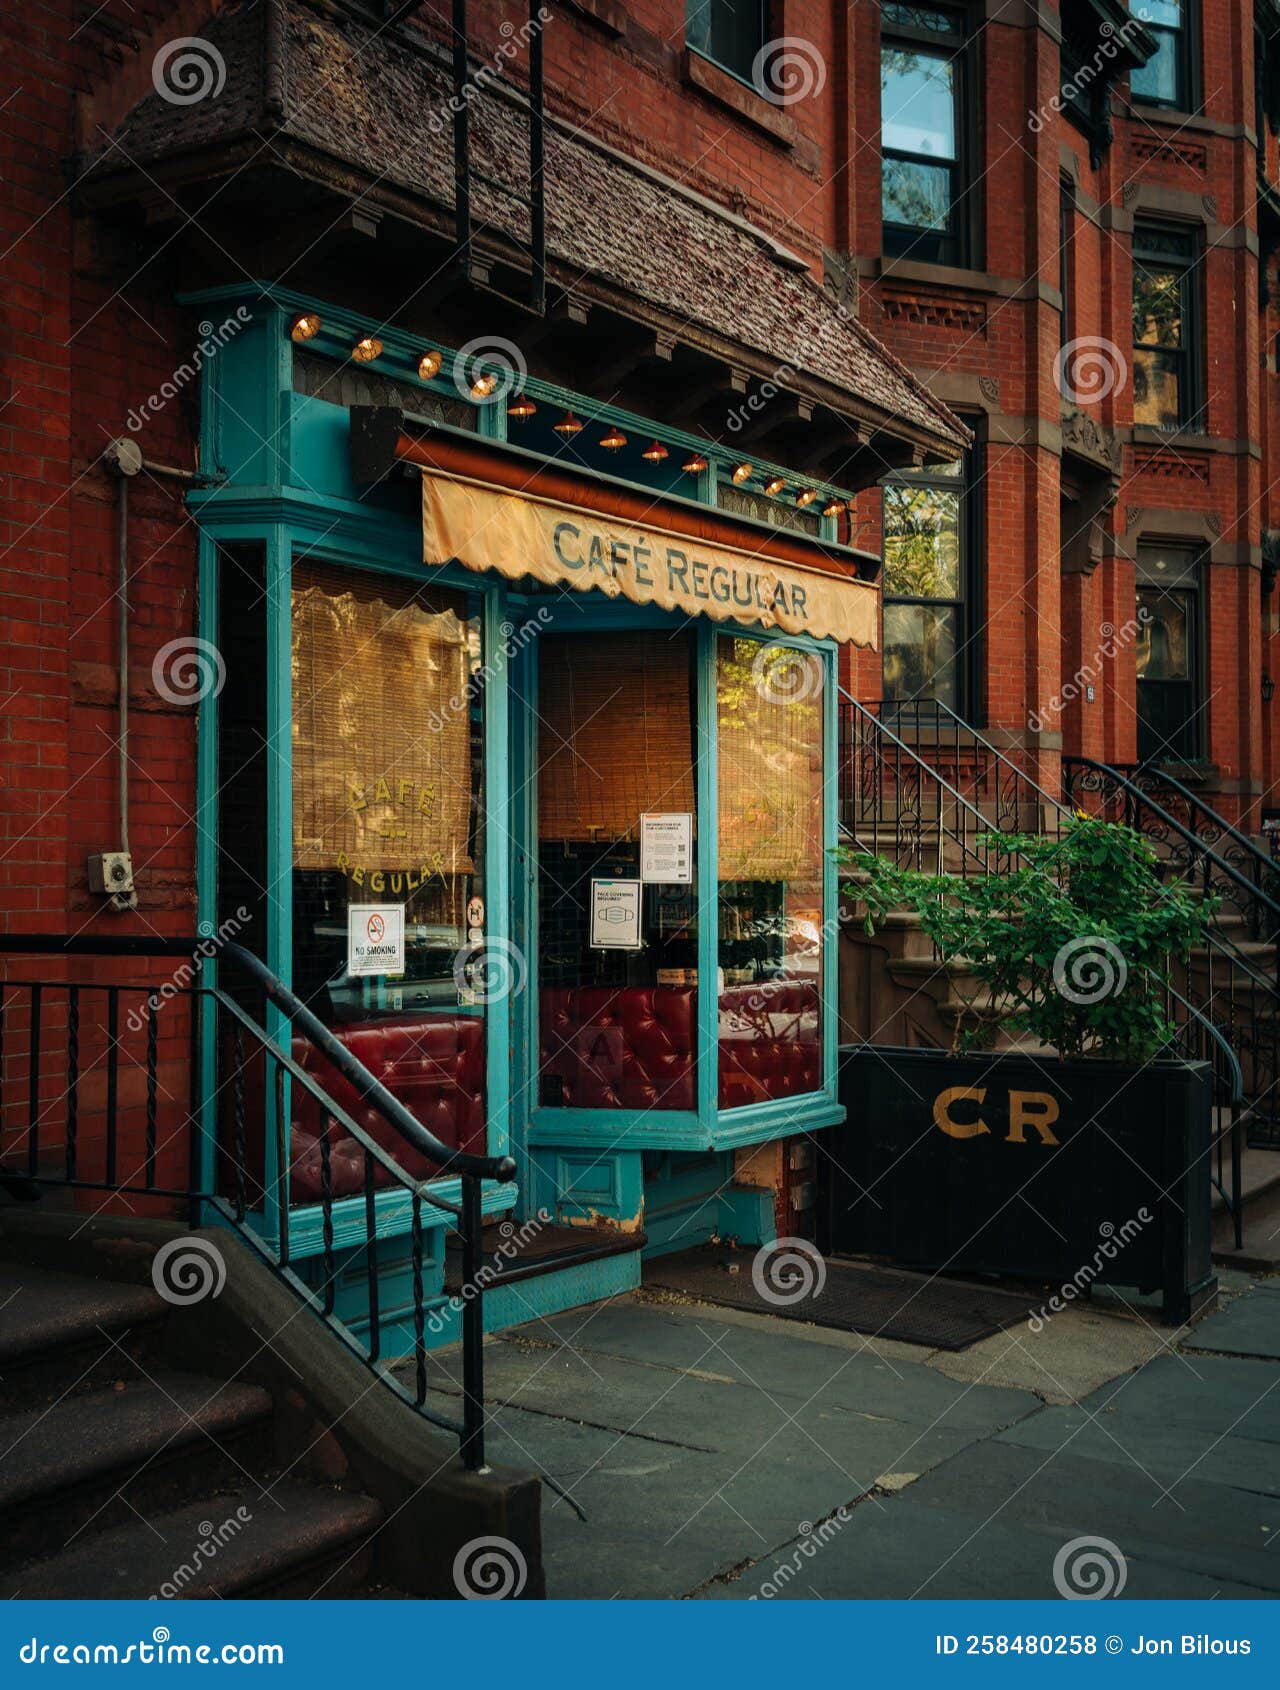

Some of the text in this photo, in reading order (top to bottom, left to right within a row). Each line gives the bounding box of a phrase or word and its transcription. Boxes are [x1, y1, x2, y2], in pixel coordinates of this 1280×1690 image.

[553, 521, 809, 620] CAFÉ REGULAR
[336, 851, 444, 894] REGULAR
[355, 945, 396, 956] NO SMOKING
